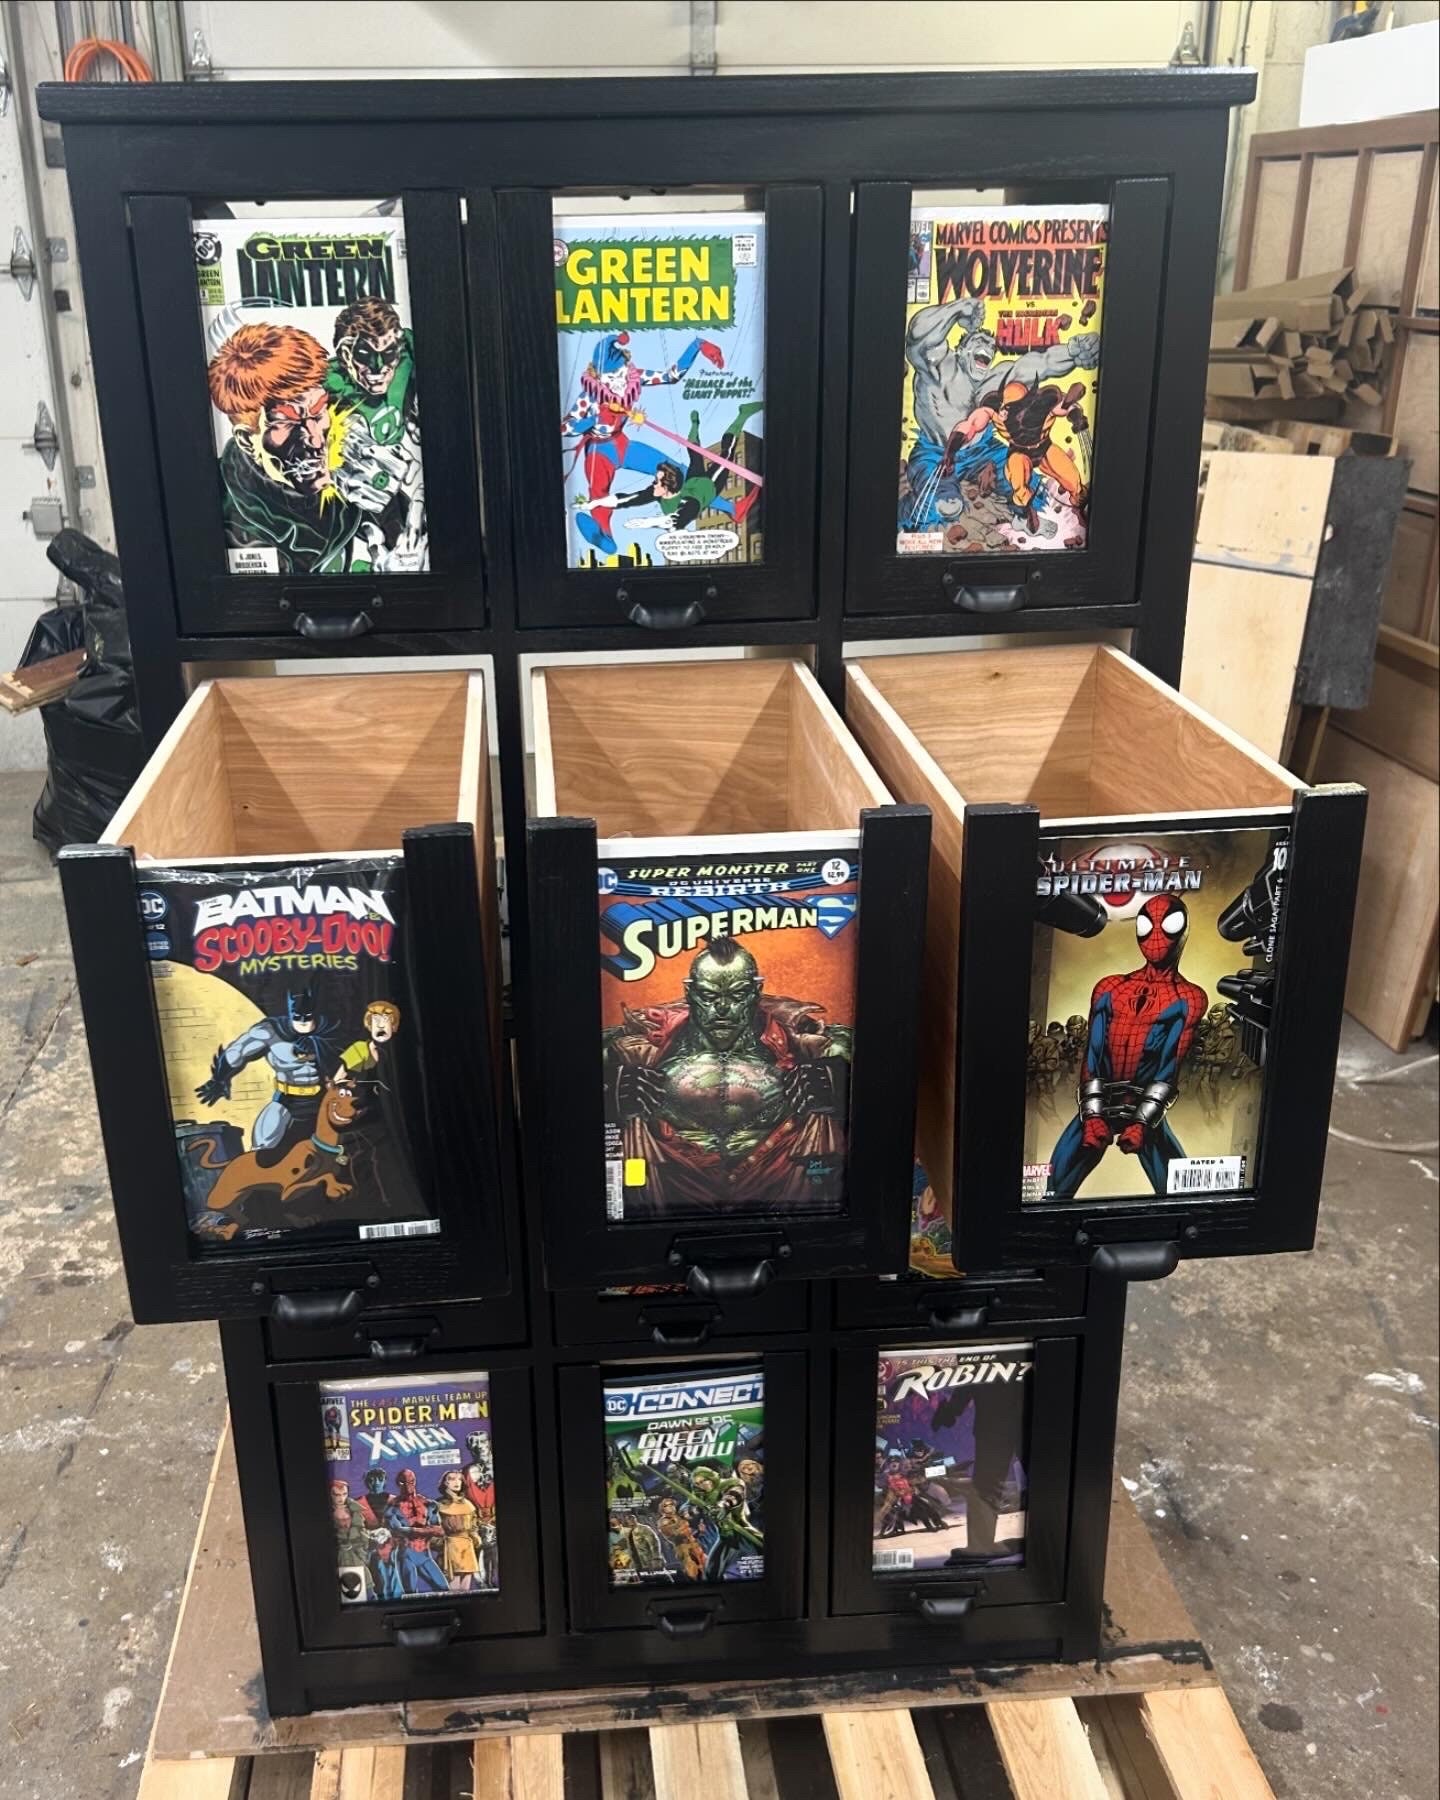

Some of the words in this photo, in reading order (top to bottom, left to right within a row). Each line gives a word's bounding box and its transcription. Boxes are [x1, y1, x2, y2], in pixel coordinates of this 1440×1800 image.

[936, 220, 986, 245] MARVEL
[989, 220, 1041, 244] COMICS
[245, 237, 385, 261] GREEN
[238, 246, 398, 308] LANTERN
[566, 246, 710, 285] GREEN
[934, 246, 1102, 304] WOLVERINE
[556, 285, 729, 324] LANTERN
[996, 317, 1060, 350] HULK
[683, 389, 712, 400] GIANT
[726, 377, 738, 388] of
[627, 867, 692, 880] SUPER
[696, 862, 789, 879] MONSTER
[832, 861, 841, 870] 12
[1051, 856, 1191, 873] ULTIMATE
[650, 883, 792, 896] REBIRTH
[692, 877, 771, 885] UNIVERSE
[1036, 870, 1203, 896] SPIDER-MAN
[193, 885, 396, 937] BATMAN
[1265, 935, 1276, 963] CLONE
[1272, 885, 1283, 906] PART
[194, 912, 392, 972] SCOOBY-DOO!
[622, 907, 819, 982] SUPERMAN
[240, 954, 358, 976] MYSTERIES
[893, 1361, 1033, 1402] ROBIN?
[351, 1399, 369, 1408] THE
[402, 1394, 440, 1405] MARVEL
[444, 1392, 471, 1402] TEAM
[475, 1391, 488, 1399] UP
[606, 1399, 627, 1411] DC
[637, 1381, 764, 1412] CONNECT
[350, 1406, 432, 1427] SPIDER
[438, 1400, 489, 1421] MN
[647, 1420, 693, 1431] DAWN
[695, 1416, 709, 1424] OF
[711, 1414, 734, 1423] DC
[356, 1426, 457, 1463] X-MEN
[637, 1429, 719, 1449] GREEN
[640, 1441, 736, 1464] ARROW
